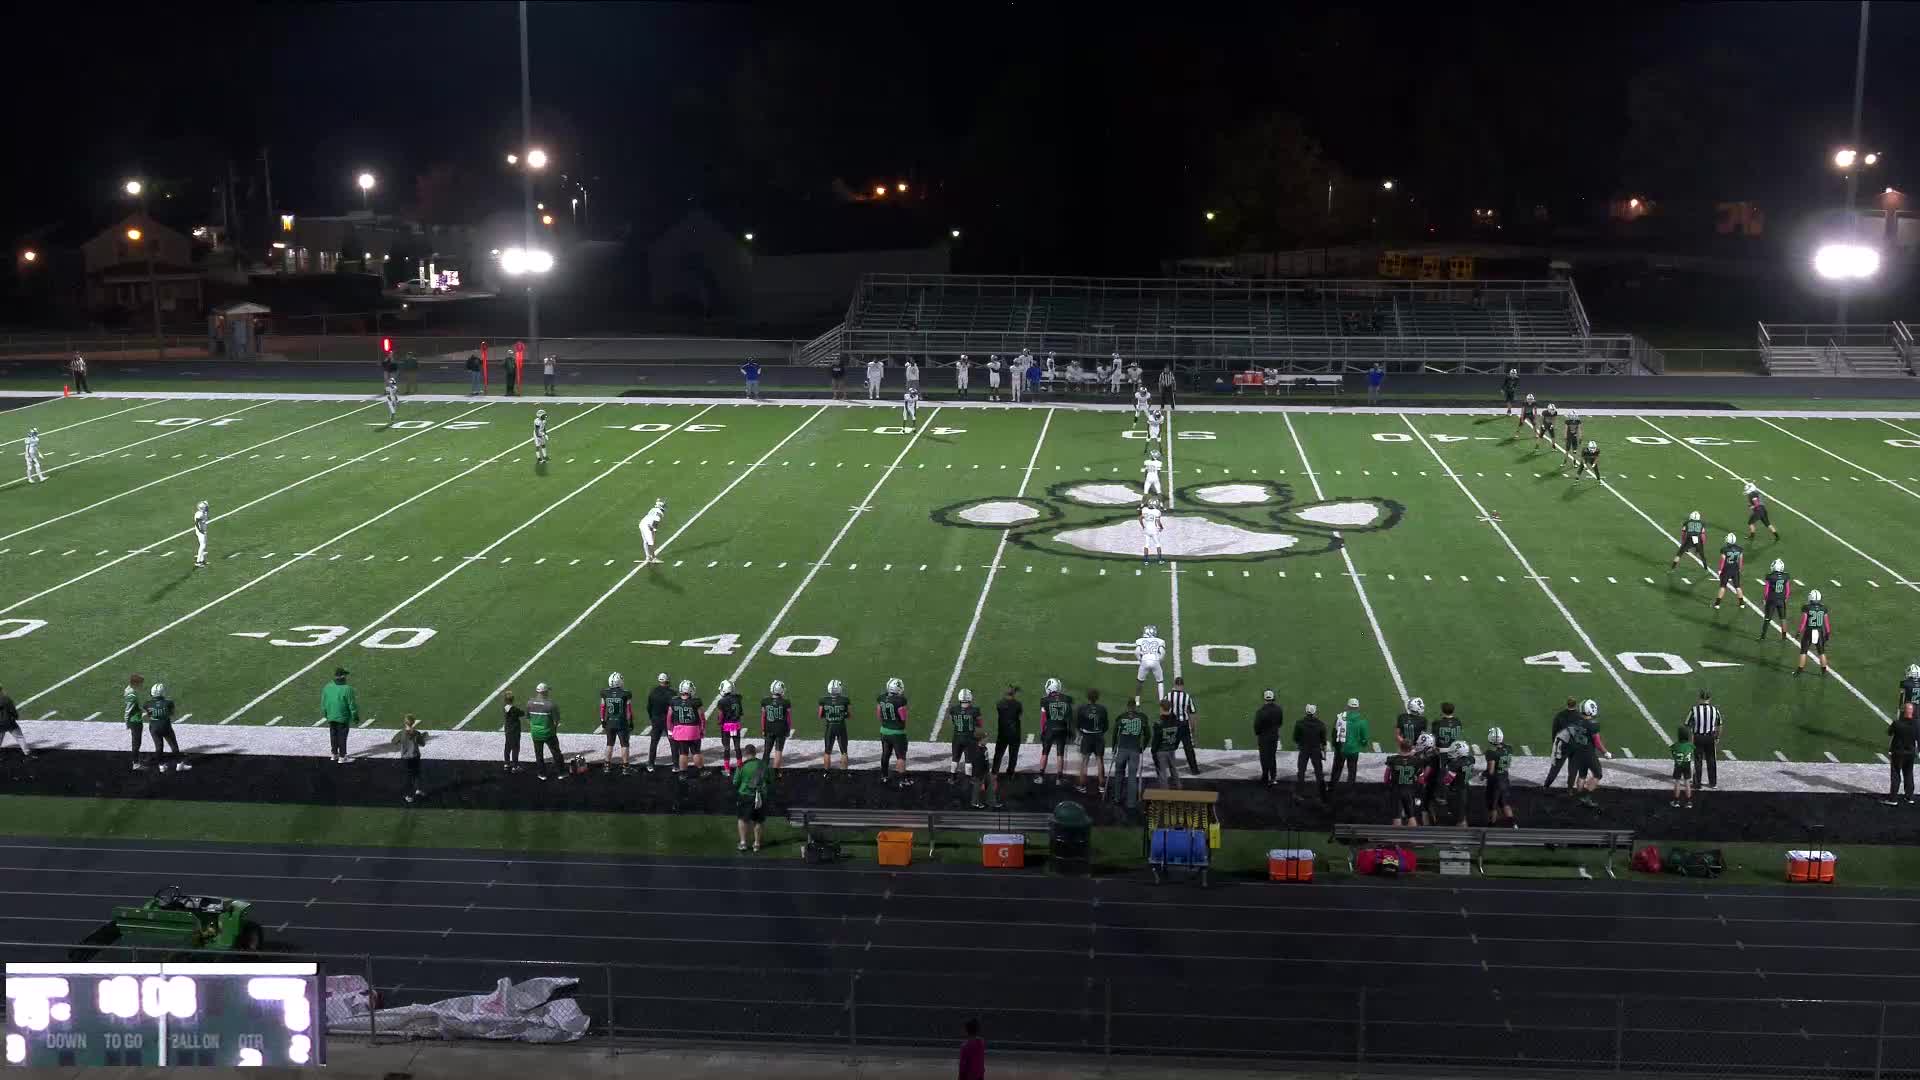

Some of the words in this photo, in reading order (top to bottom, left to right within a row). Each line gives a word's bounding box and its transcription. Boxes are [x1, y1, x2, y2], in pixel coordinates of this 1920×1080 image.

[629, 423, 727, 432] 30
[1808, 610, 1825, 627] 20
[267, 625, 439, 650] 30
[678, 633, 840, 657] 40
[1096, 641, 1257, 667] 50
[1523, 651, 1694, 675] 40
[606, 697, 623, 714] 57
[1120, 718, 1142, 735] 30
